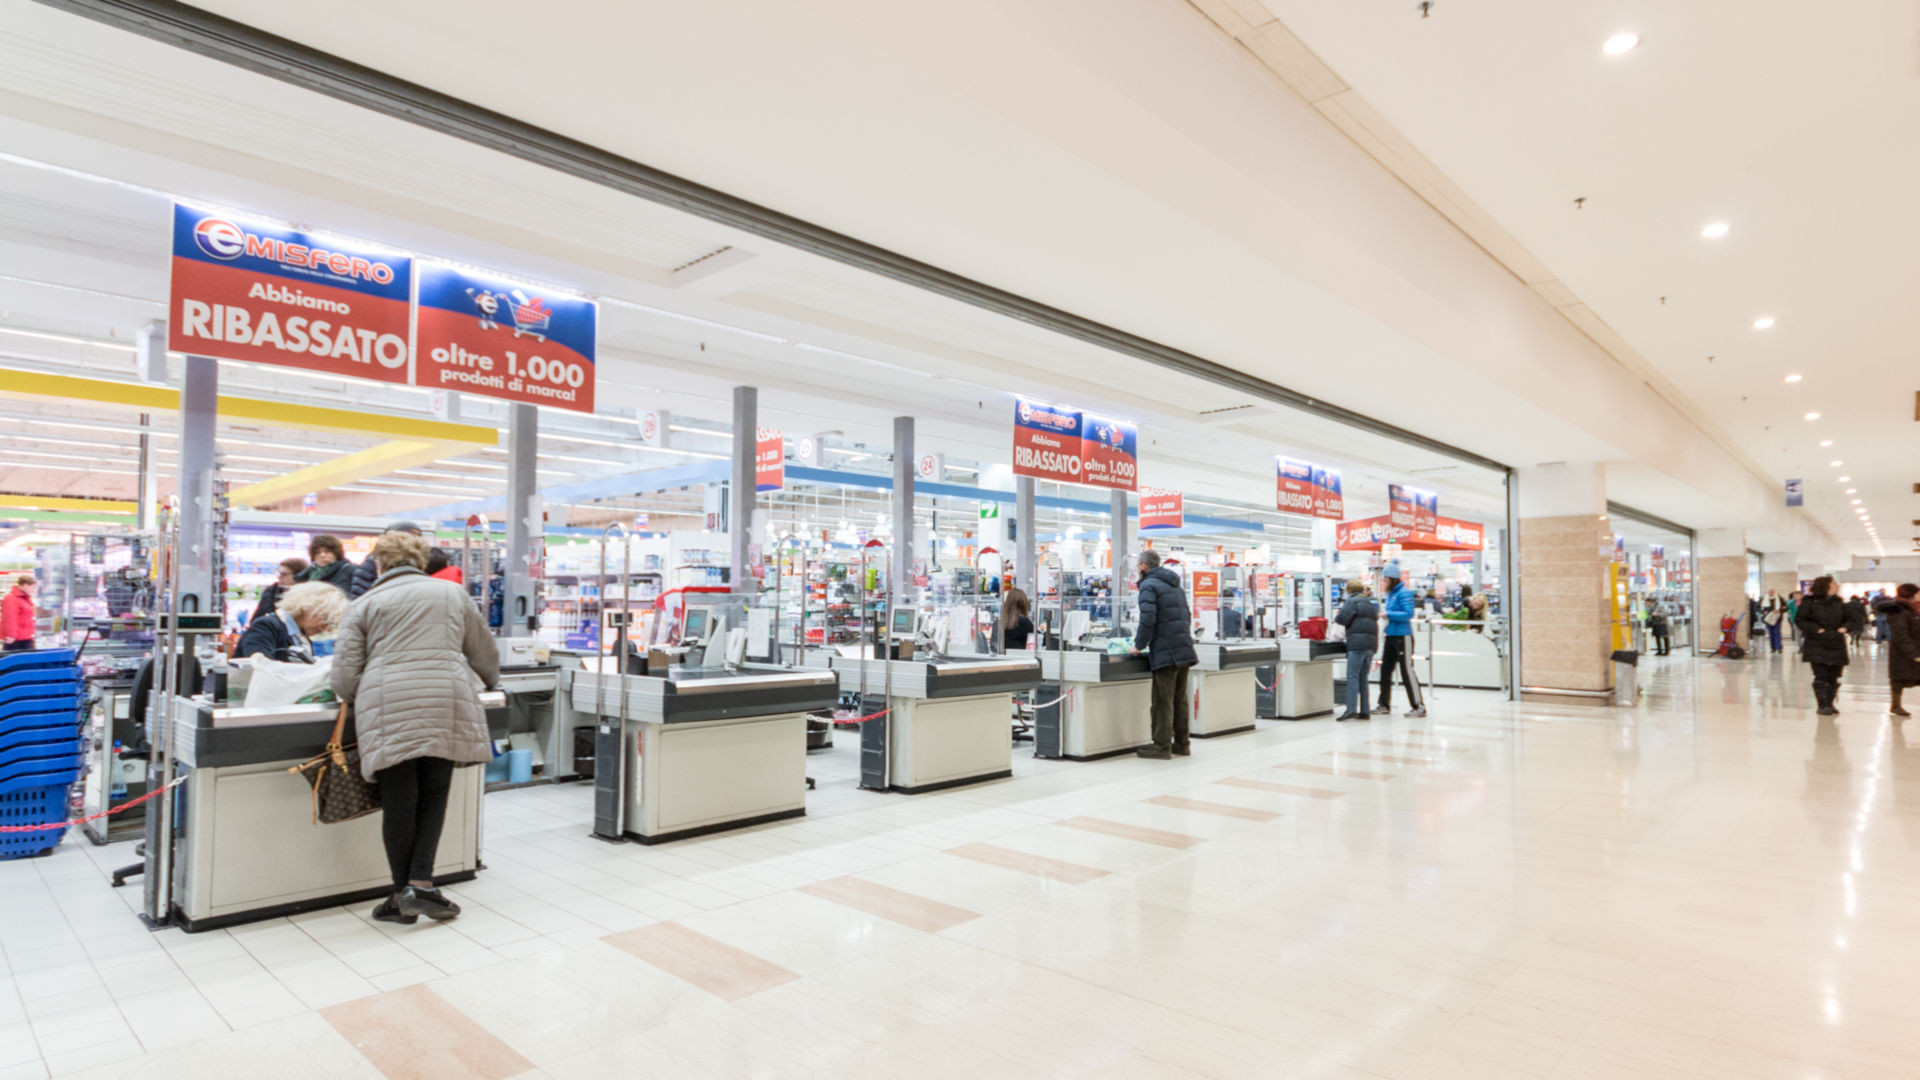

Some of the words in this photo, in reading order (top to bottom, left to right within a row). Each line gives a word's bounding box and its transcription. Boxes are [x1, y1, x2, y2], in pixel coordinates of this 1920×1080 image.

[248, 282, 350, 316] Abbiamo
[182, 298, 407, 369] RIBASSATO
[431, 343, 494, 372] oltre
[505, 351, 584, 388] 1.000
[440, 368, 504, 389] prodotti
[508, 377, 523, 393] di
[526, 383, 577, 401] marca!
[1032, 434, 1061, 448] Abbiamo
[1015, 446, 1081, 476] RIBASSATO
[1084, 458, 1106, 473] oltre
[1109, 460, 1135, 478] 1.000
[1350, 527, 1371, 544] CASSA
